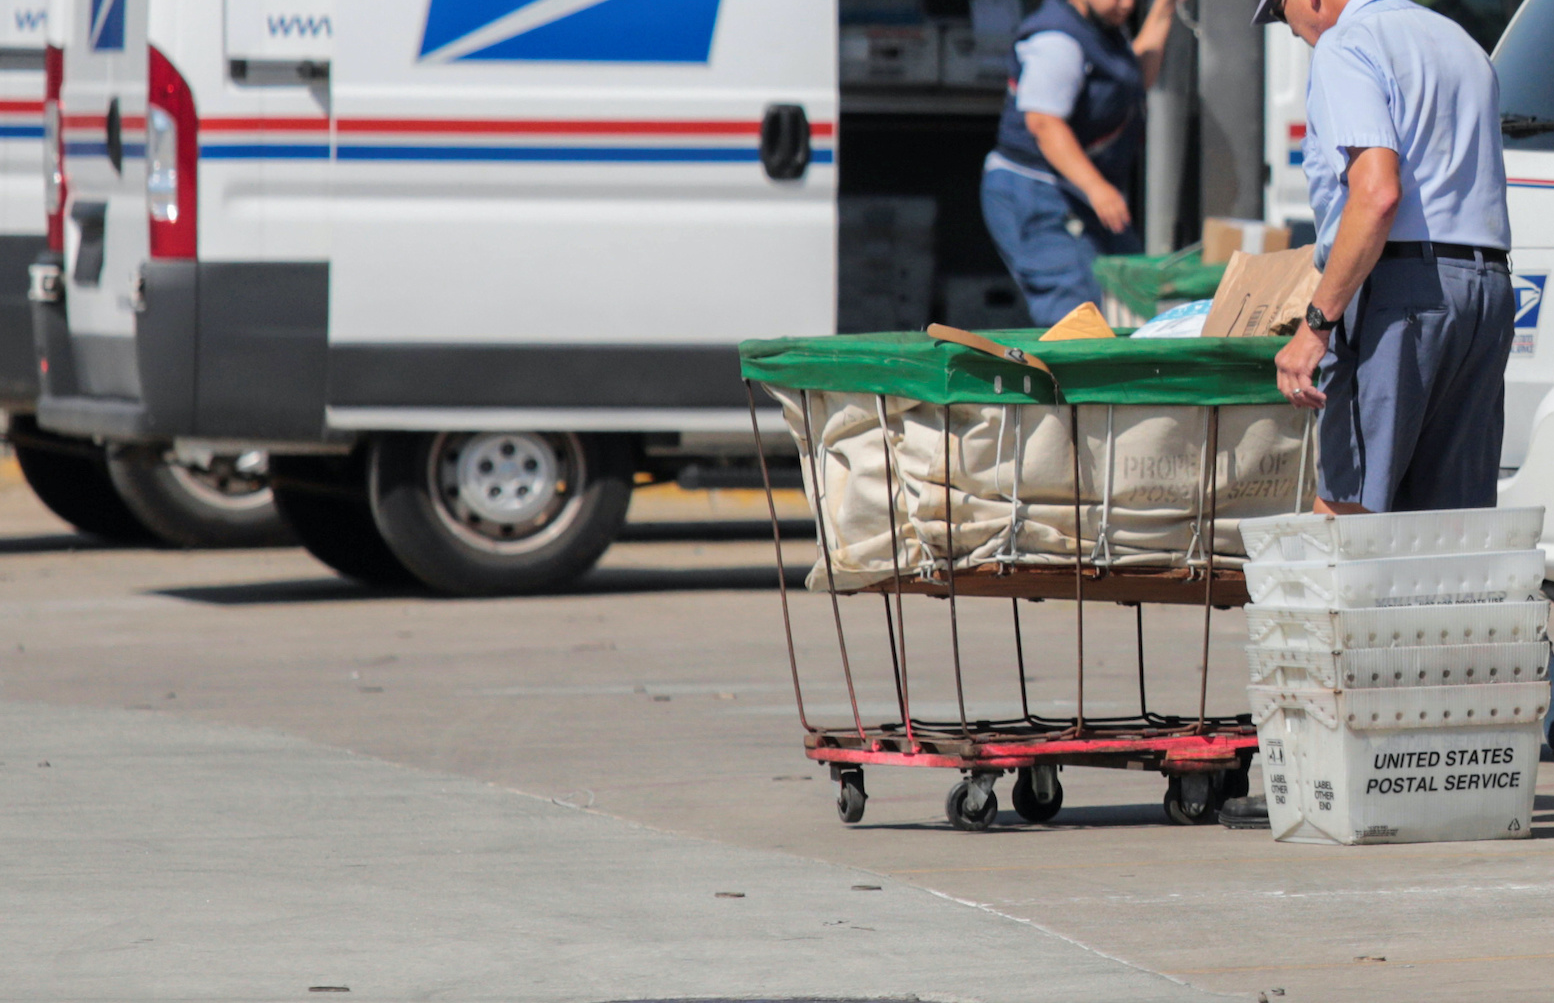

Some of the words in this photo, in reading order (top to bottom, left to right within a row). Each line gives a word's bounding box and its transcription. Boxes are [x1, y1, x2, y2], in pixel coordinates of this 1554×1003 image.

[1259, 453, 1288, 476] OF
[1374, 751, 1440, 770] UNITED
[1445, 747, 1514, 766] STATES
[1270, 774, 1287, 784] LABEL
[1366, 776, 1438, 794] POSTAL
[1444, 772, 1521, 791] SERVICE
[1271, 785, 1288, 794] OTHER
[1314, 780, 1333, 790] LABEL
[1275, 795, 1286, 804] END
[1314, 791, 1334, 800] OTHER
[1319, 801, 1331, 811] END
